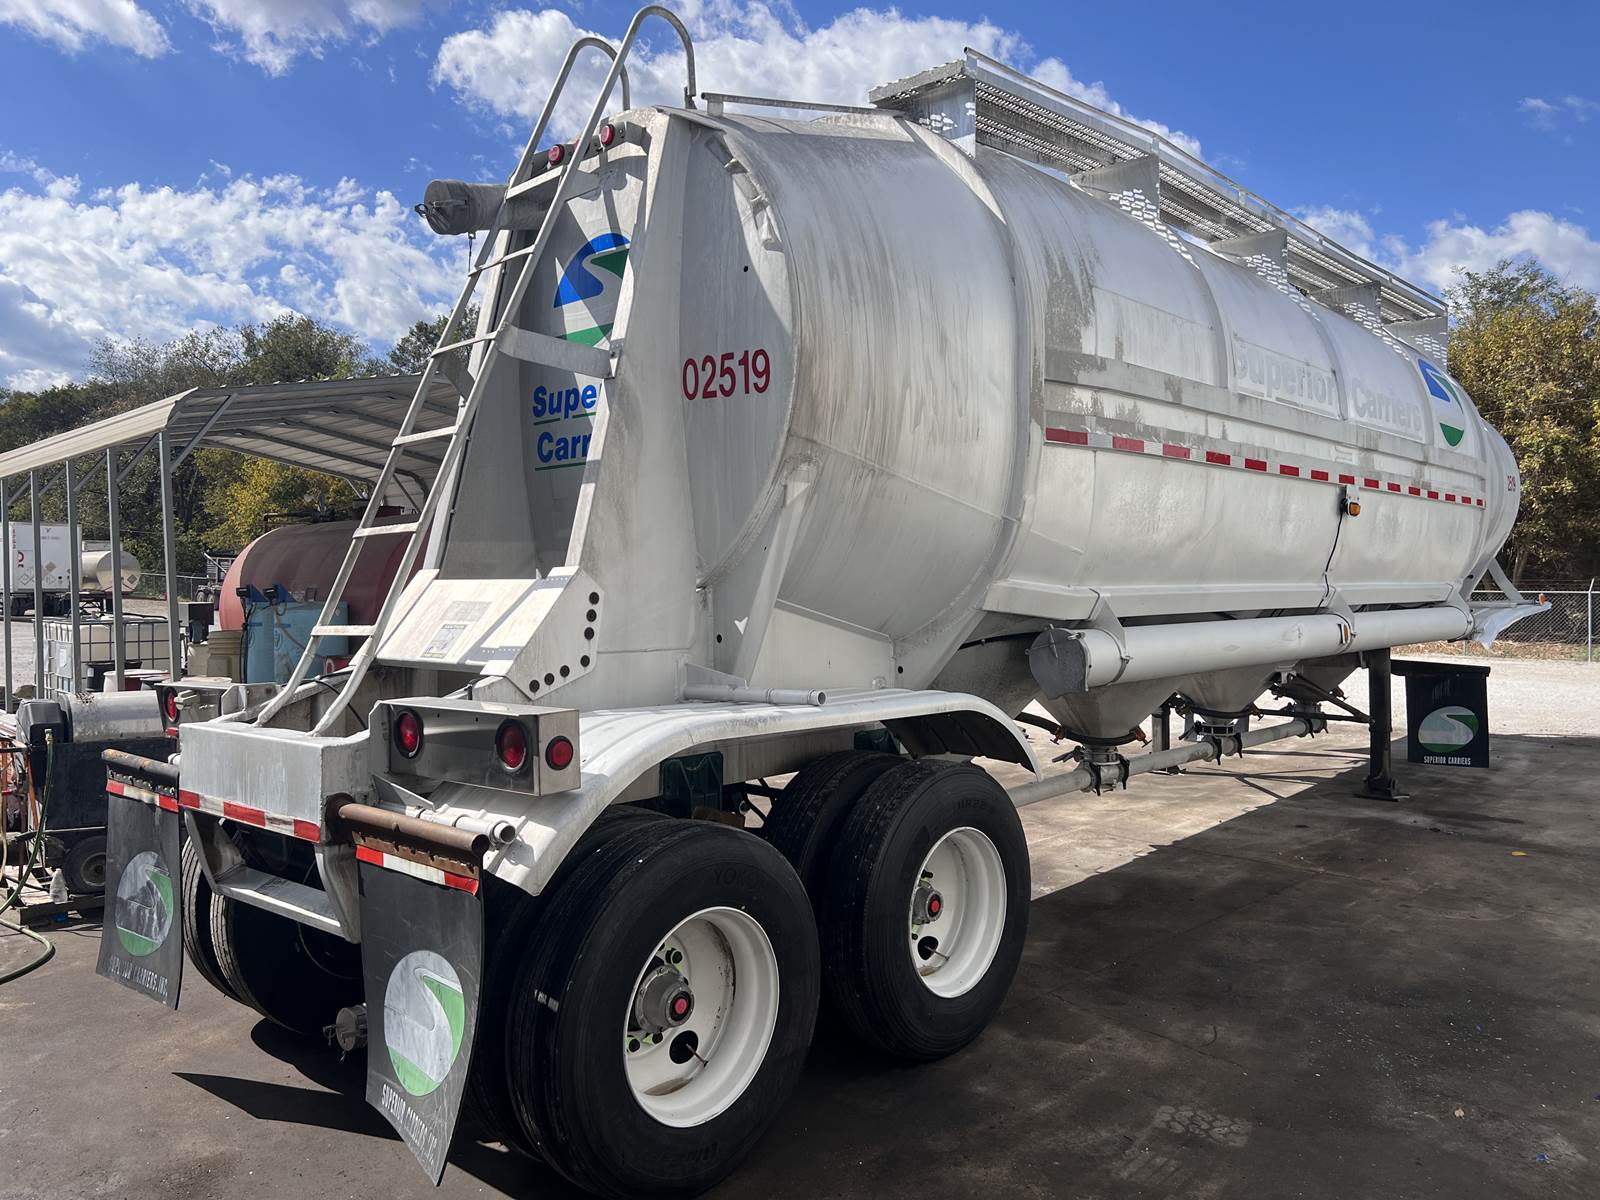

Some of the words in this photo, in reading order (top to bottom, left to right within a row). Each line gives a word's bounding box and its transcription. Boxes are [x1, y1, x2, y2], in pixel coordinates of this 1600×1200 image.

[682, 348, 771, 401] 02519
[532, 384, 597, 419] Supe
[537, 431, 593, 463] Carr
[1423, 755, 1446, 764] SUPERIOR
[1447, 757, 1471, 766] CARRIERS
